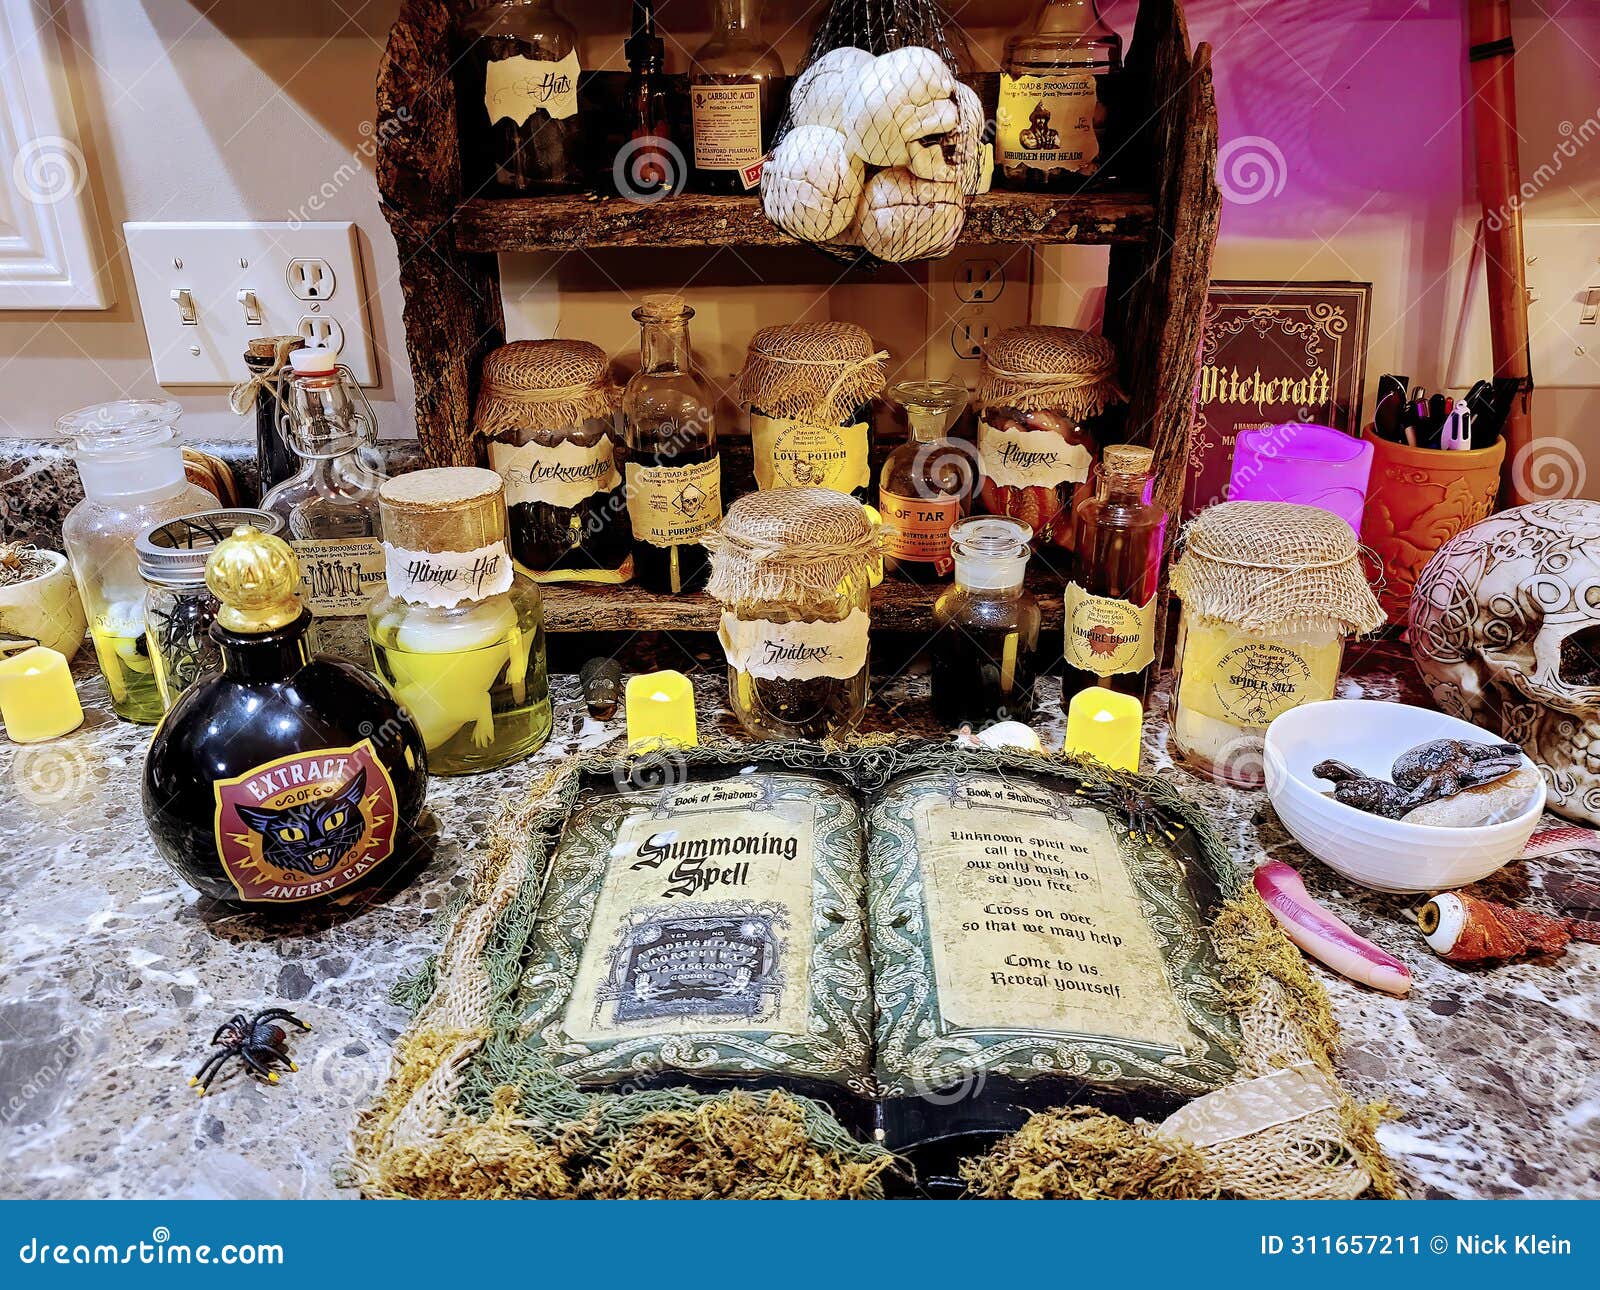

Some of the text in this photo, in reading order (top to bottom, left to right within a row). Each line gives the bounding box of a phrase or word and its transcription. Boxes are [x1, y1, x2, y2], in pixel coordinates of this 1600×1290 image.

[1043, 81, 1091, 90] BROOMSTICK
[707, 91, 755, 101] CARBOLIC ACID
[774, 438, 783, 450] THE
[782, 424, 798, 437] TOAD
[774, 450, 847, 461] LOVE POTION
[895, 508, 912, 520] OF
[916, 511, 945, 522] TAR
[652, 523, 704, 537] ALL PURPOSE
[302, 546, 320, 554] TOAD
[329, 543, 375, 552] BROOMSTICK
[360, 571, 387, 582] DUST
[1072, 607, 1081, 618] THE
[1080, 599, 1095, 609] TOAD
[1104, 600, 1143, 628] BROOMSTICK
[1072, 623, 1140, 644] VAMPIRE BLOOD
[1217, 653, 1233, 669] THE
[1231, 644, 1257, 656] TOAD
[1268, 644, 1312, 680] BROOMSTICK
[1229, 674, 1269, 691] SPIDER
[246, 757, 349, 802] EXTRACT
[296, 788, 311, 801] OF
[674, 790, 758, 808] Book of Shadows
[966, 787, 1053, 806] Book of Shadows
[630, 830, 799, 872] Summoning
[950, 830, 1090, 855] Unknown spirit we
[984, 845, 1065, 866] call to thee,
[263, 851, 377, 899] ANGRY CAT
[661, 857, 751, 899] Spell
[967, 860, 1089, 882] our only wish to
[987, 874, 1078, 894] set you free.
[983, 903, 1098, 929] Cross on over,
[670, 932, 688, 940] YES
[961, 920, 1128, 948] so that we may help.
[655, 962, 734, 975] 1234567890
[1004, 953, 1104, 977] Come to us.
[670, 972, 715, 982] GOODBYE
[990, 971, 1127, 999] Reveal yourself.
